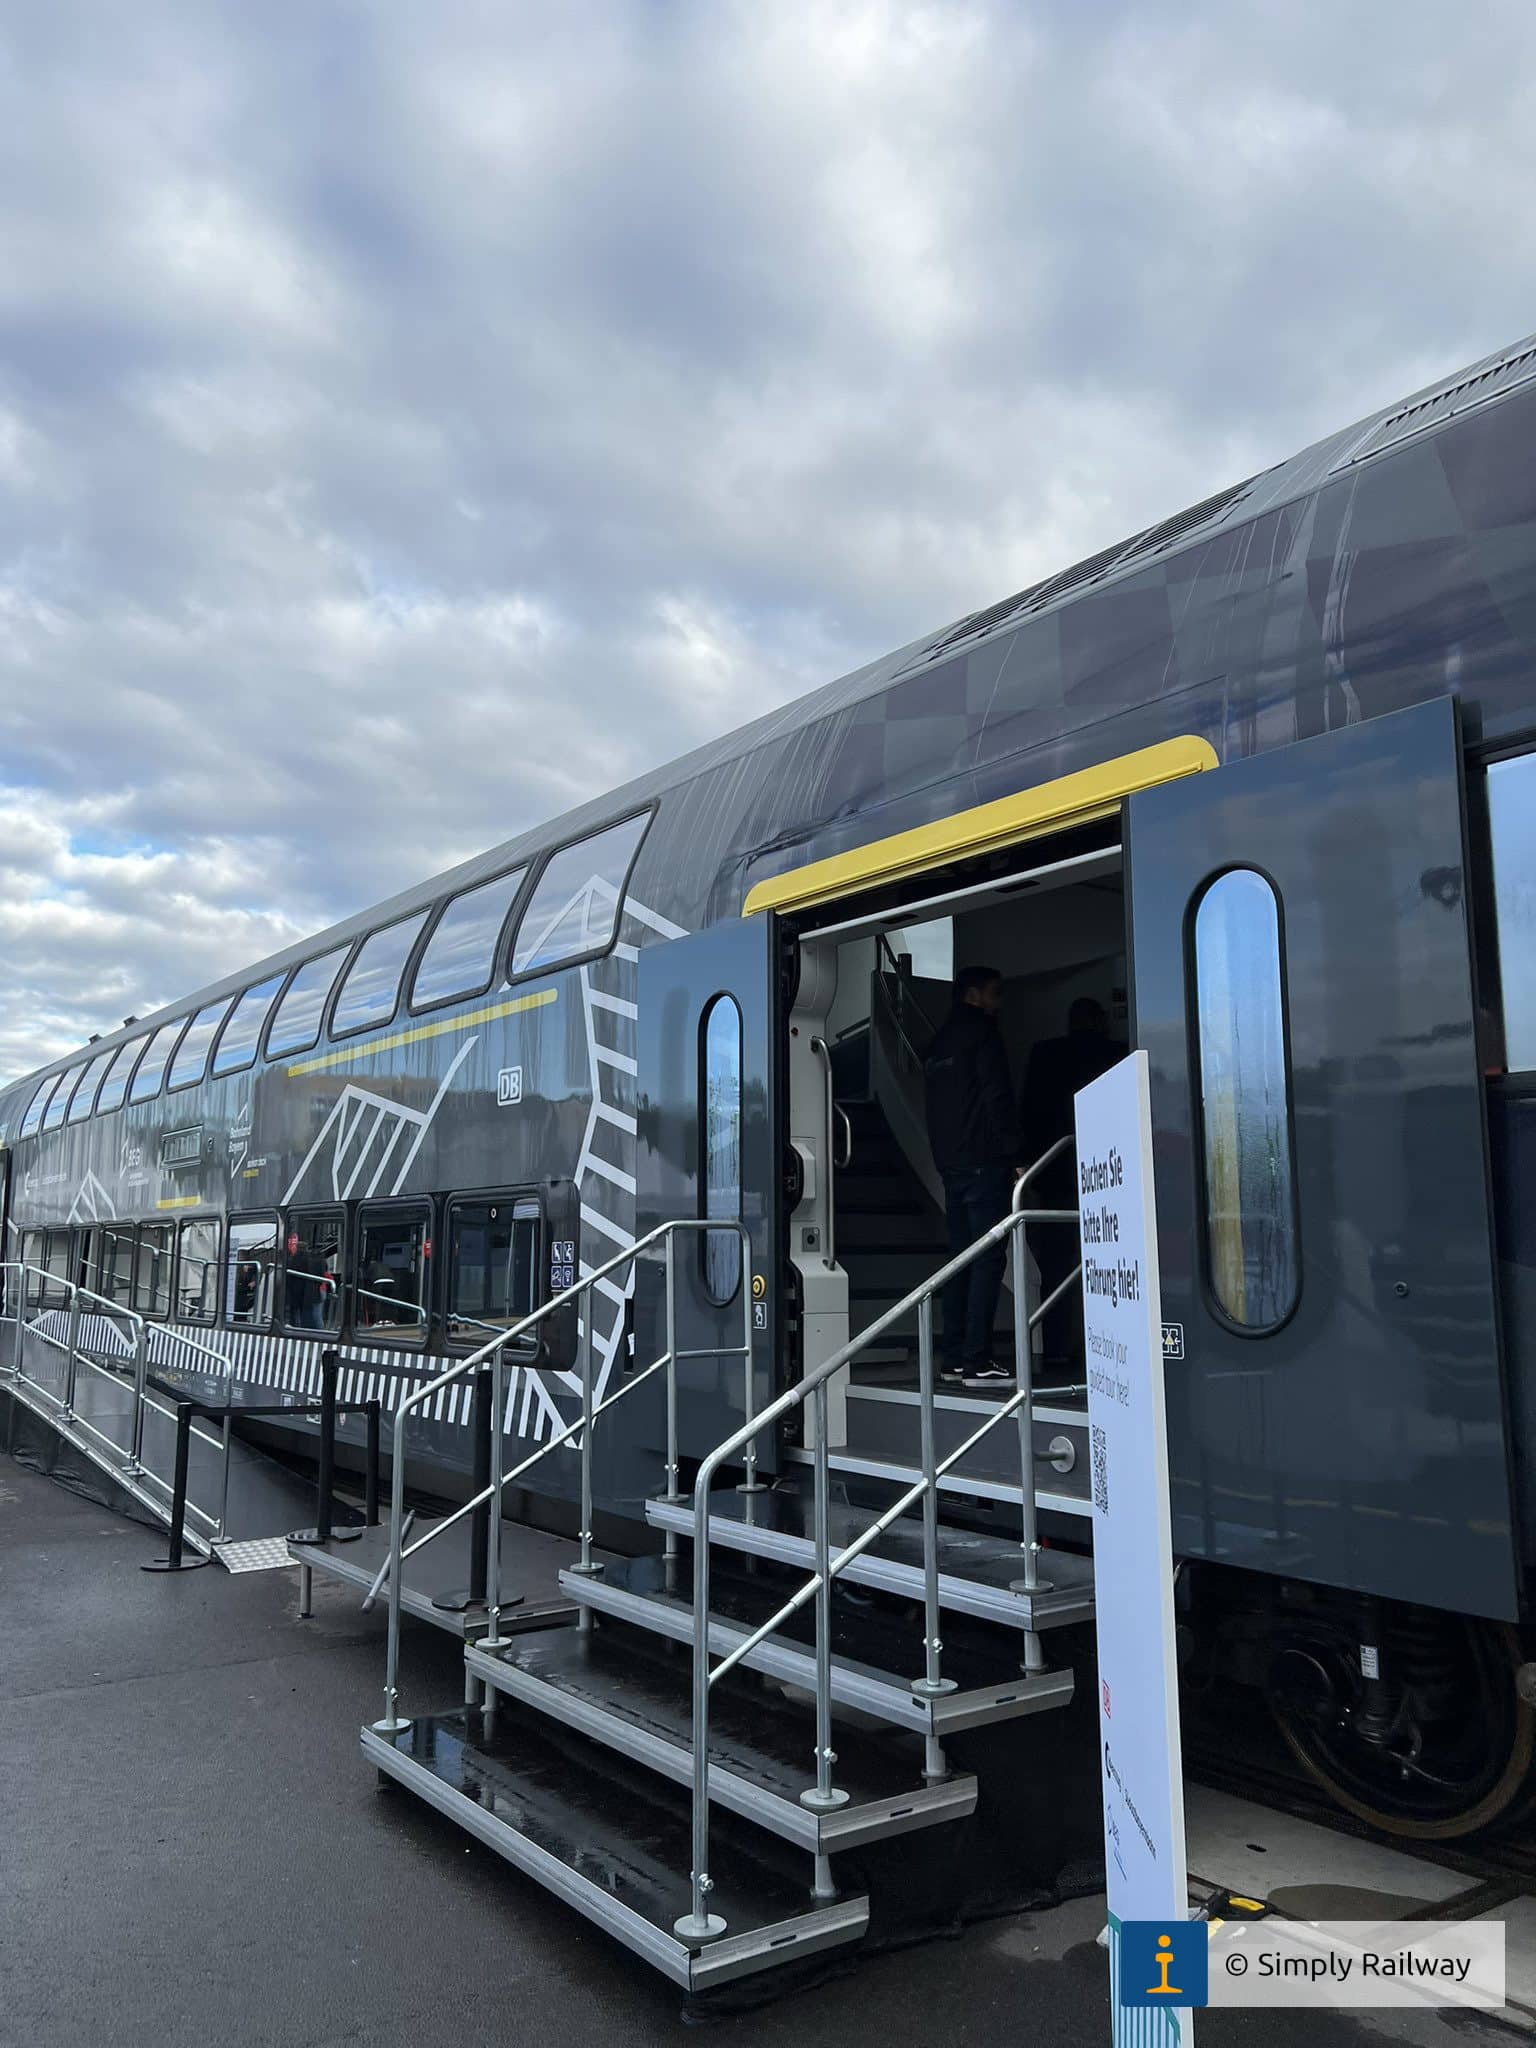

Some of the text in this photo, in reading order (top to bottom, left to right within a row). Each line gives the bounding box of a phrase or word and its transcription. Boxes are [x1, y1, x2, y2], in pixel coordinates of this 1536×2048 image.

[500, 1071, 520, 1101] DB
[1081, 1146, 1123, 1194] Buchen Sie
[1083, 1206, 1119, 1244] bitte Ihre
[1085, 1257, 1139, 1308] Führung hier!
